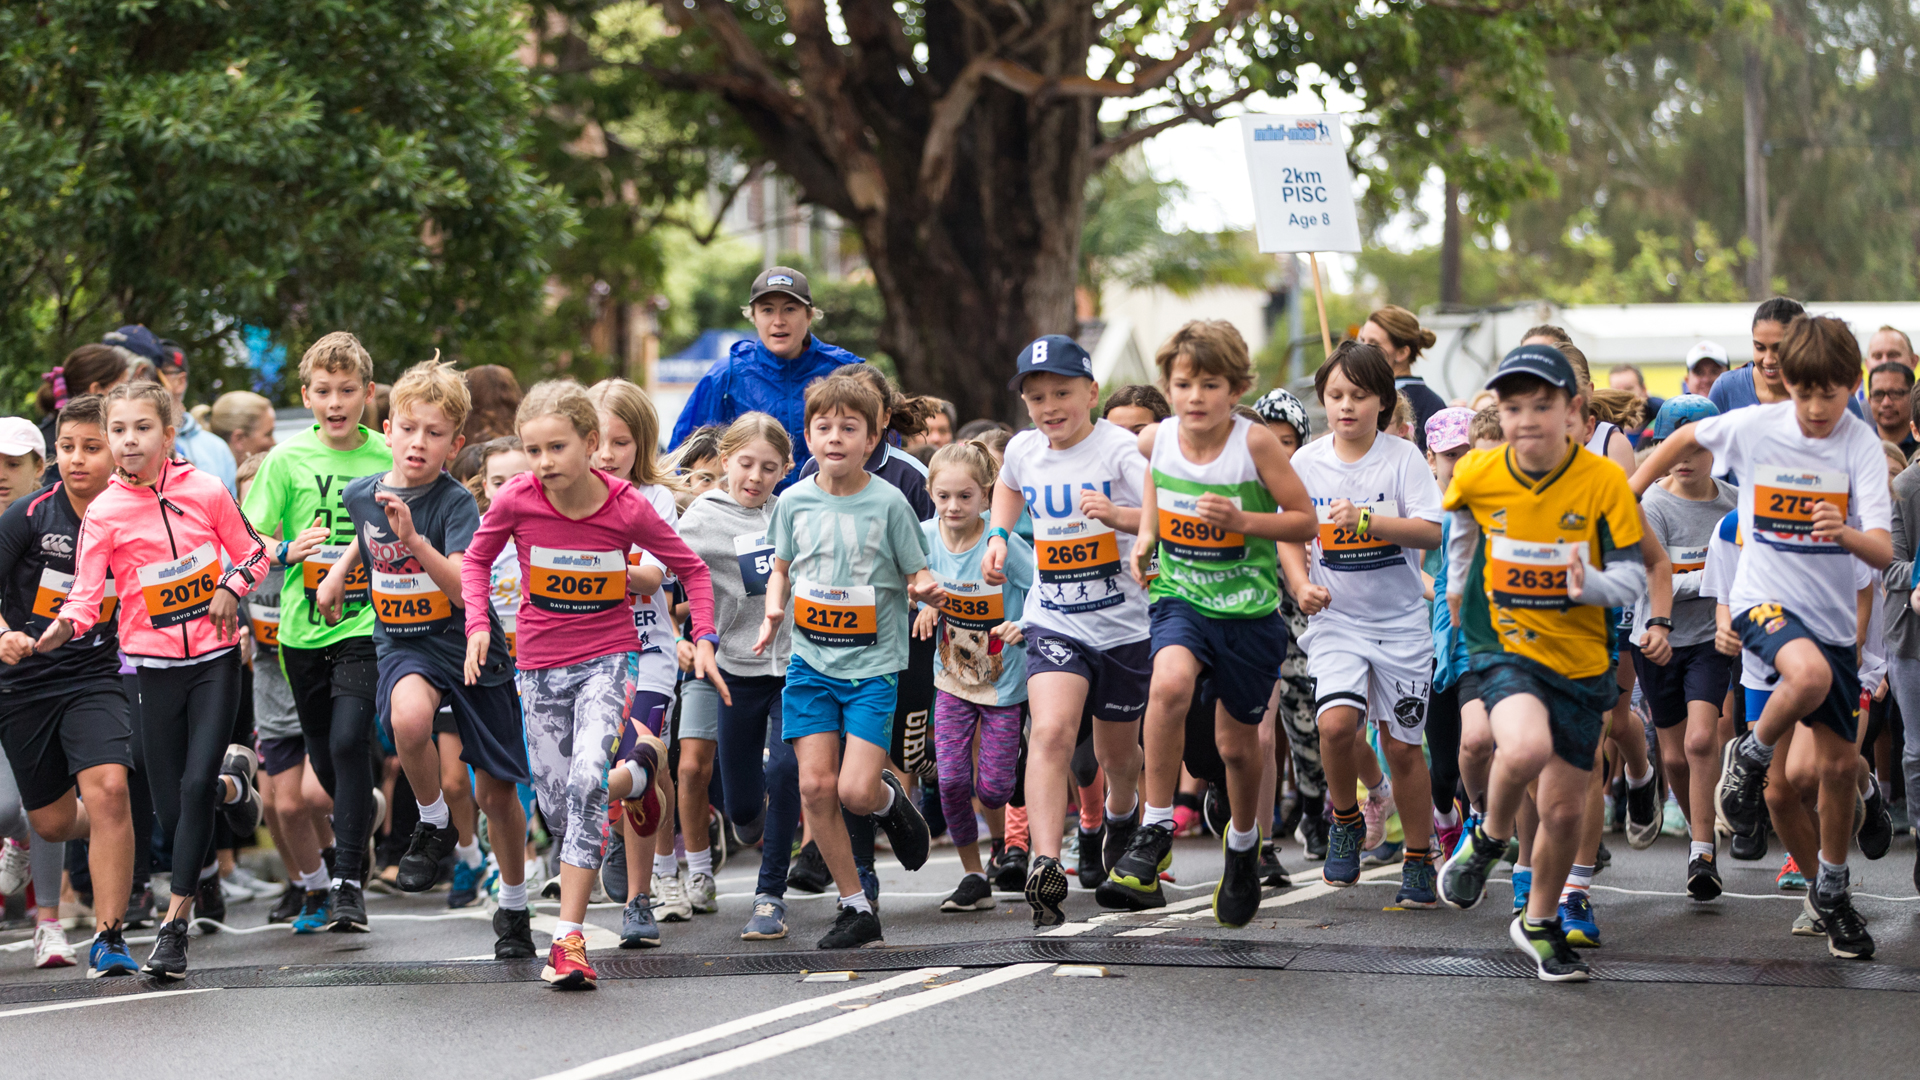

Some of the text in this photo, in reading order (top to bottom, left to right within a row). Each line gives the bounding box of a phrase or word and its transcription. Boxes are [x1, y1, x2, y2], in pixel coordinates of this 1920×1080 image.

[1282, 167, 1322, 183] 2km
[1282, 186, 1328, 202] PISC
[1289, 212, 1330, 229] Age 8
[1032, 340, 1048, 365] B
[1770, 493, 1825, 515] 275
[1170, 518, 1226, 542] 2690
[1333, 528, 1383, 545] 220
[369, 538, 411, 561] BOR
[1047, 541, 1099, 564] 2667
[1174, 547, 1192, 555] DAVID
[317, 567, 368, 585] 252
[546, 574, 608, 595] 2067
[1507, 568, 1567, 589] 2632
[160, 573, 214, 607] 2076
[171, 605, 210, 622] DAVID MURP
[381, 598, 432, 617] 2748
[550, 602, 571, 610] DAVID
[943, 596, 989, 615] 2538
[633, 610, 657, 627] ER
[807, 606, 858, 629] 2172
[946, 616, 960, 625] DAVID
[1396, 681, 1429, 698] AIR
